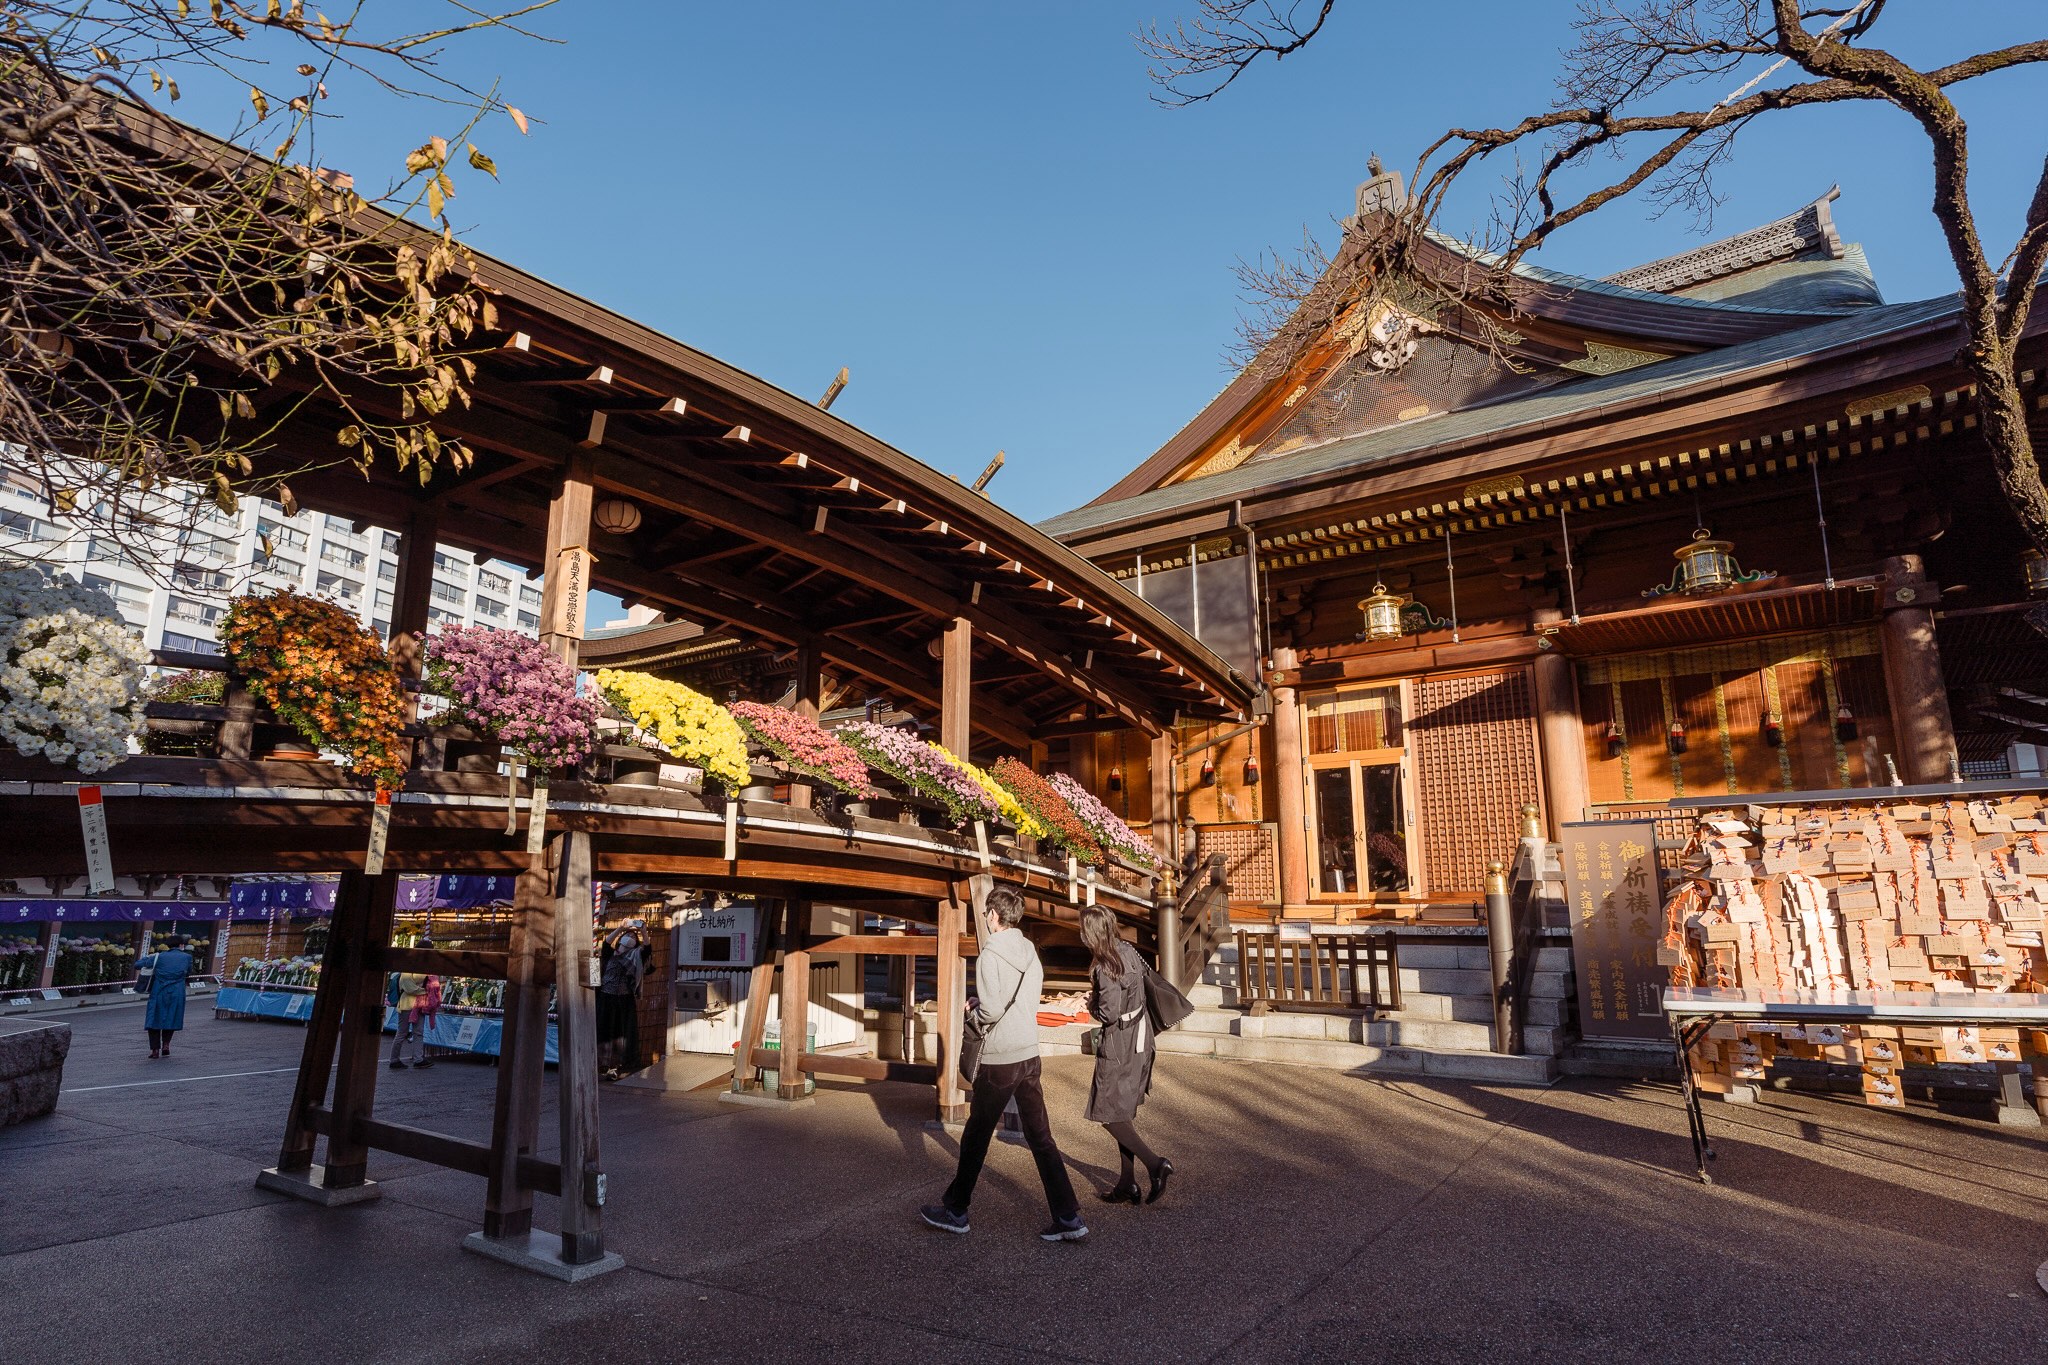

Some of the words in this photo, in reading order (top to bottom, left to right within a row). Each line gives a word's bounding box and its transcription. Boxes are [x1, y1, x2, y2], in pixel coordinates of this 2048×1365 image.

[566, 550, 582, 634] 湯島天満宮崇敬会
[698, 914, 736, 929] 古札納所
[1618, 839, 1655, 968] 御祈祷受付
